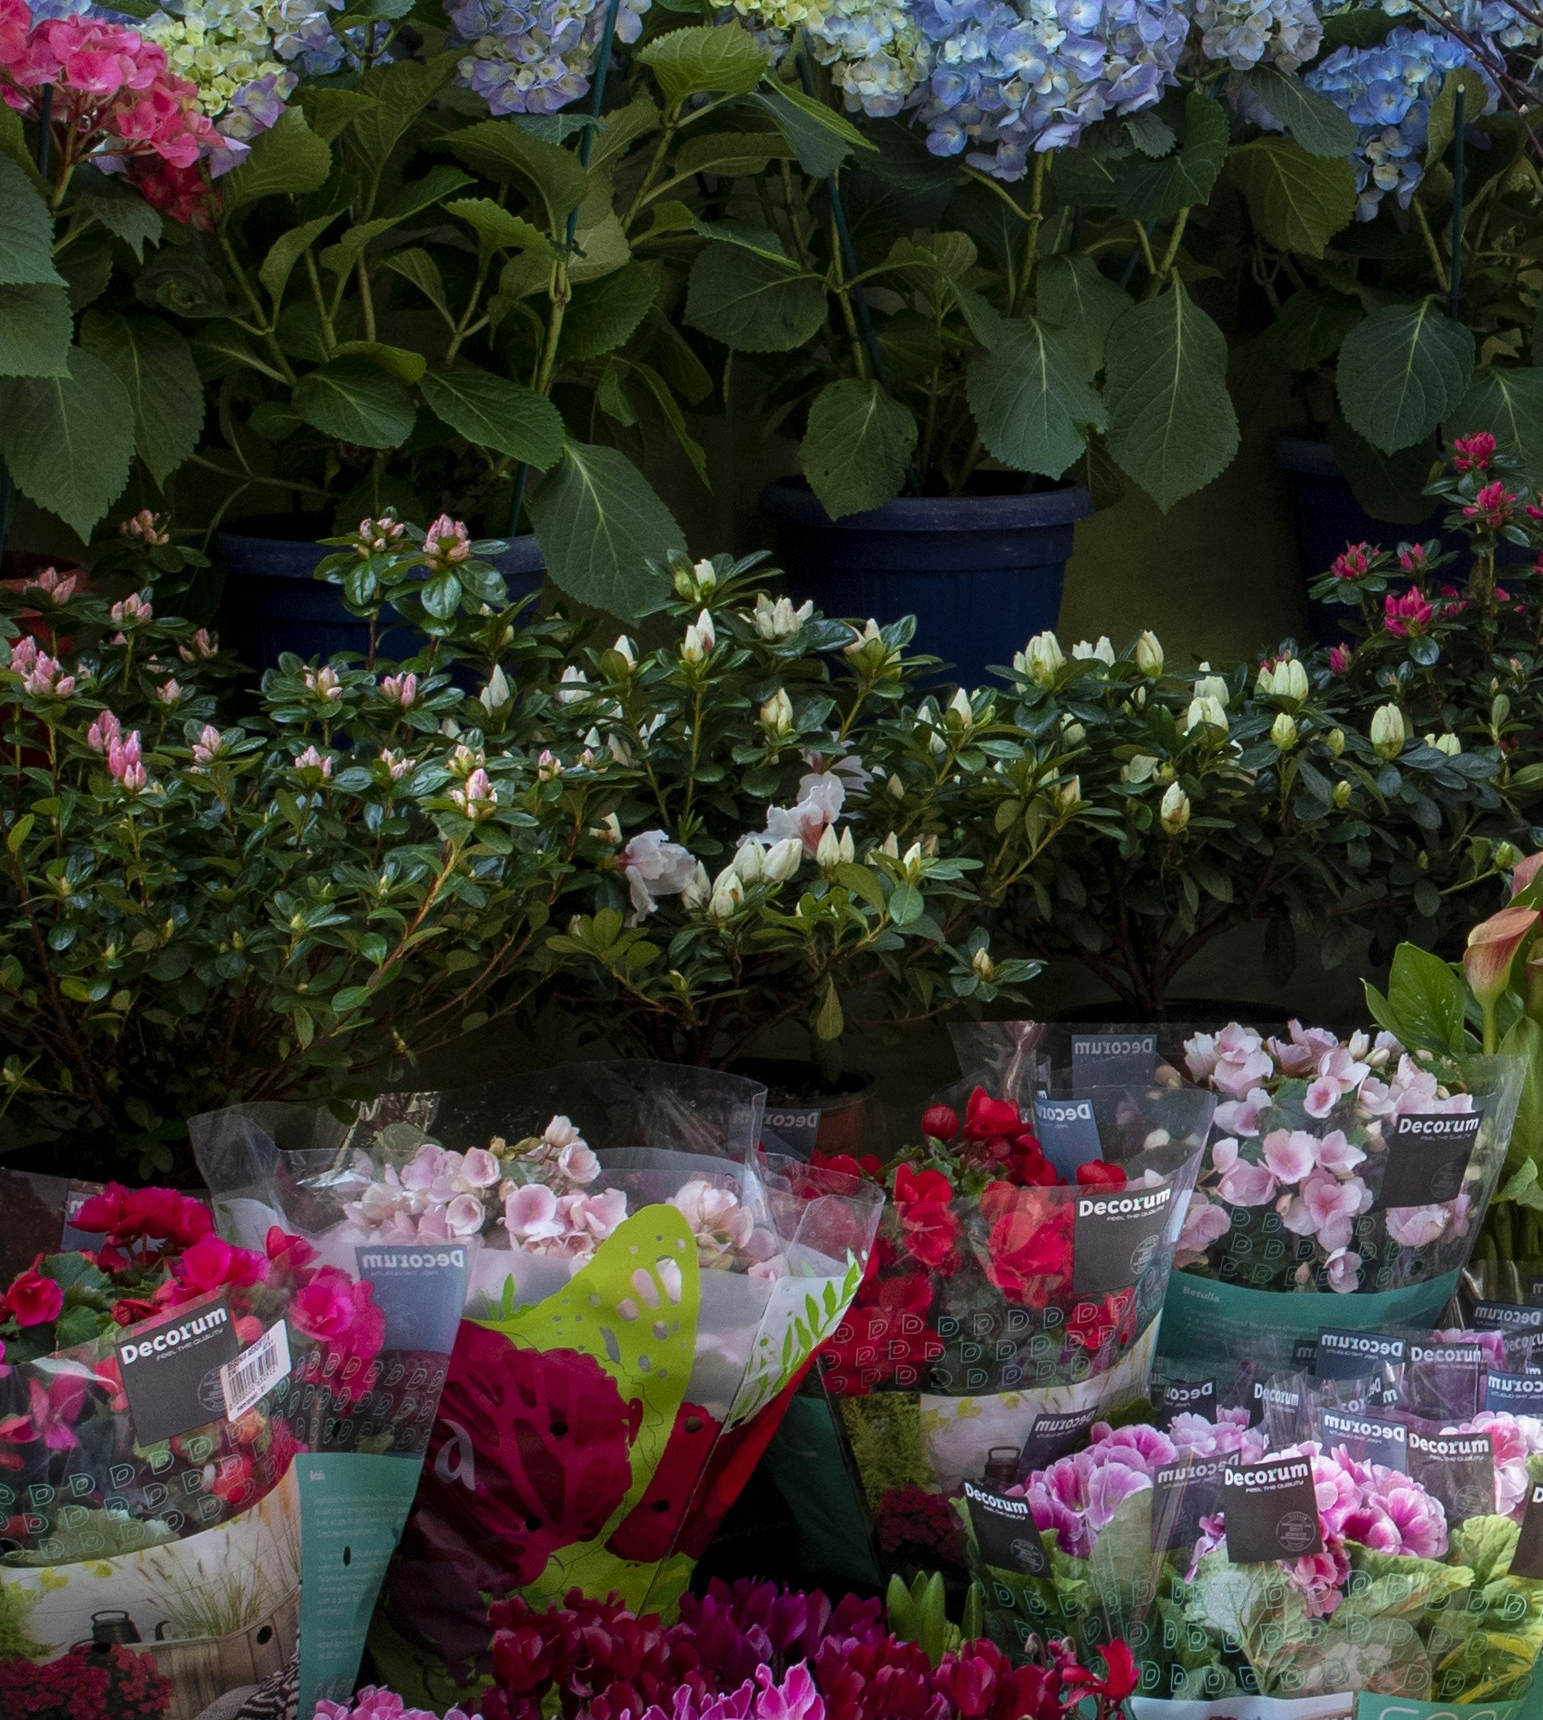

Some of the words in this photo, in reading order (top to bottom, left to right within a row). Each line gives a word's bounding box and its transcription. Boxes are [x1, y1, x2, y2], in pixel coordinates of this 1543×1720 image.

[1398, 1117, 1479, 1135] Decorum
[1079, 1188, 1170, 1217] Decorum
[120, 1307, 228, 1365] Decorum
[1409, 1433, 1489, 1454] Decorum
[1225, 1463, 1309, 1486] Decorum
[965, 1482, 1028, 1514] Decorum
